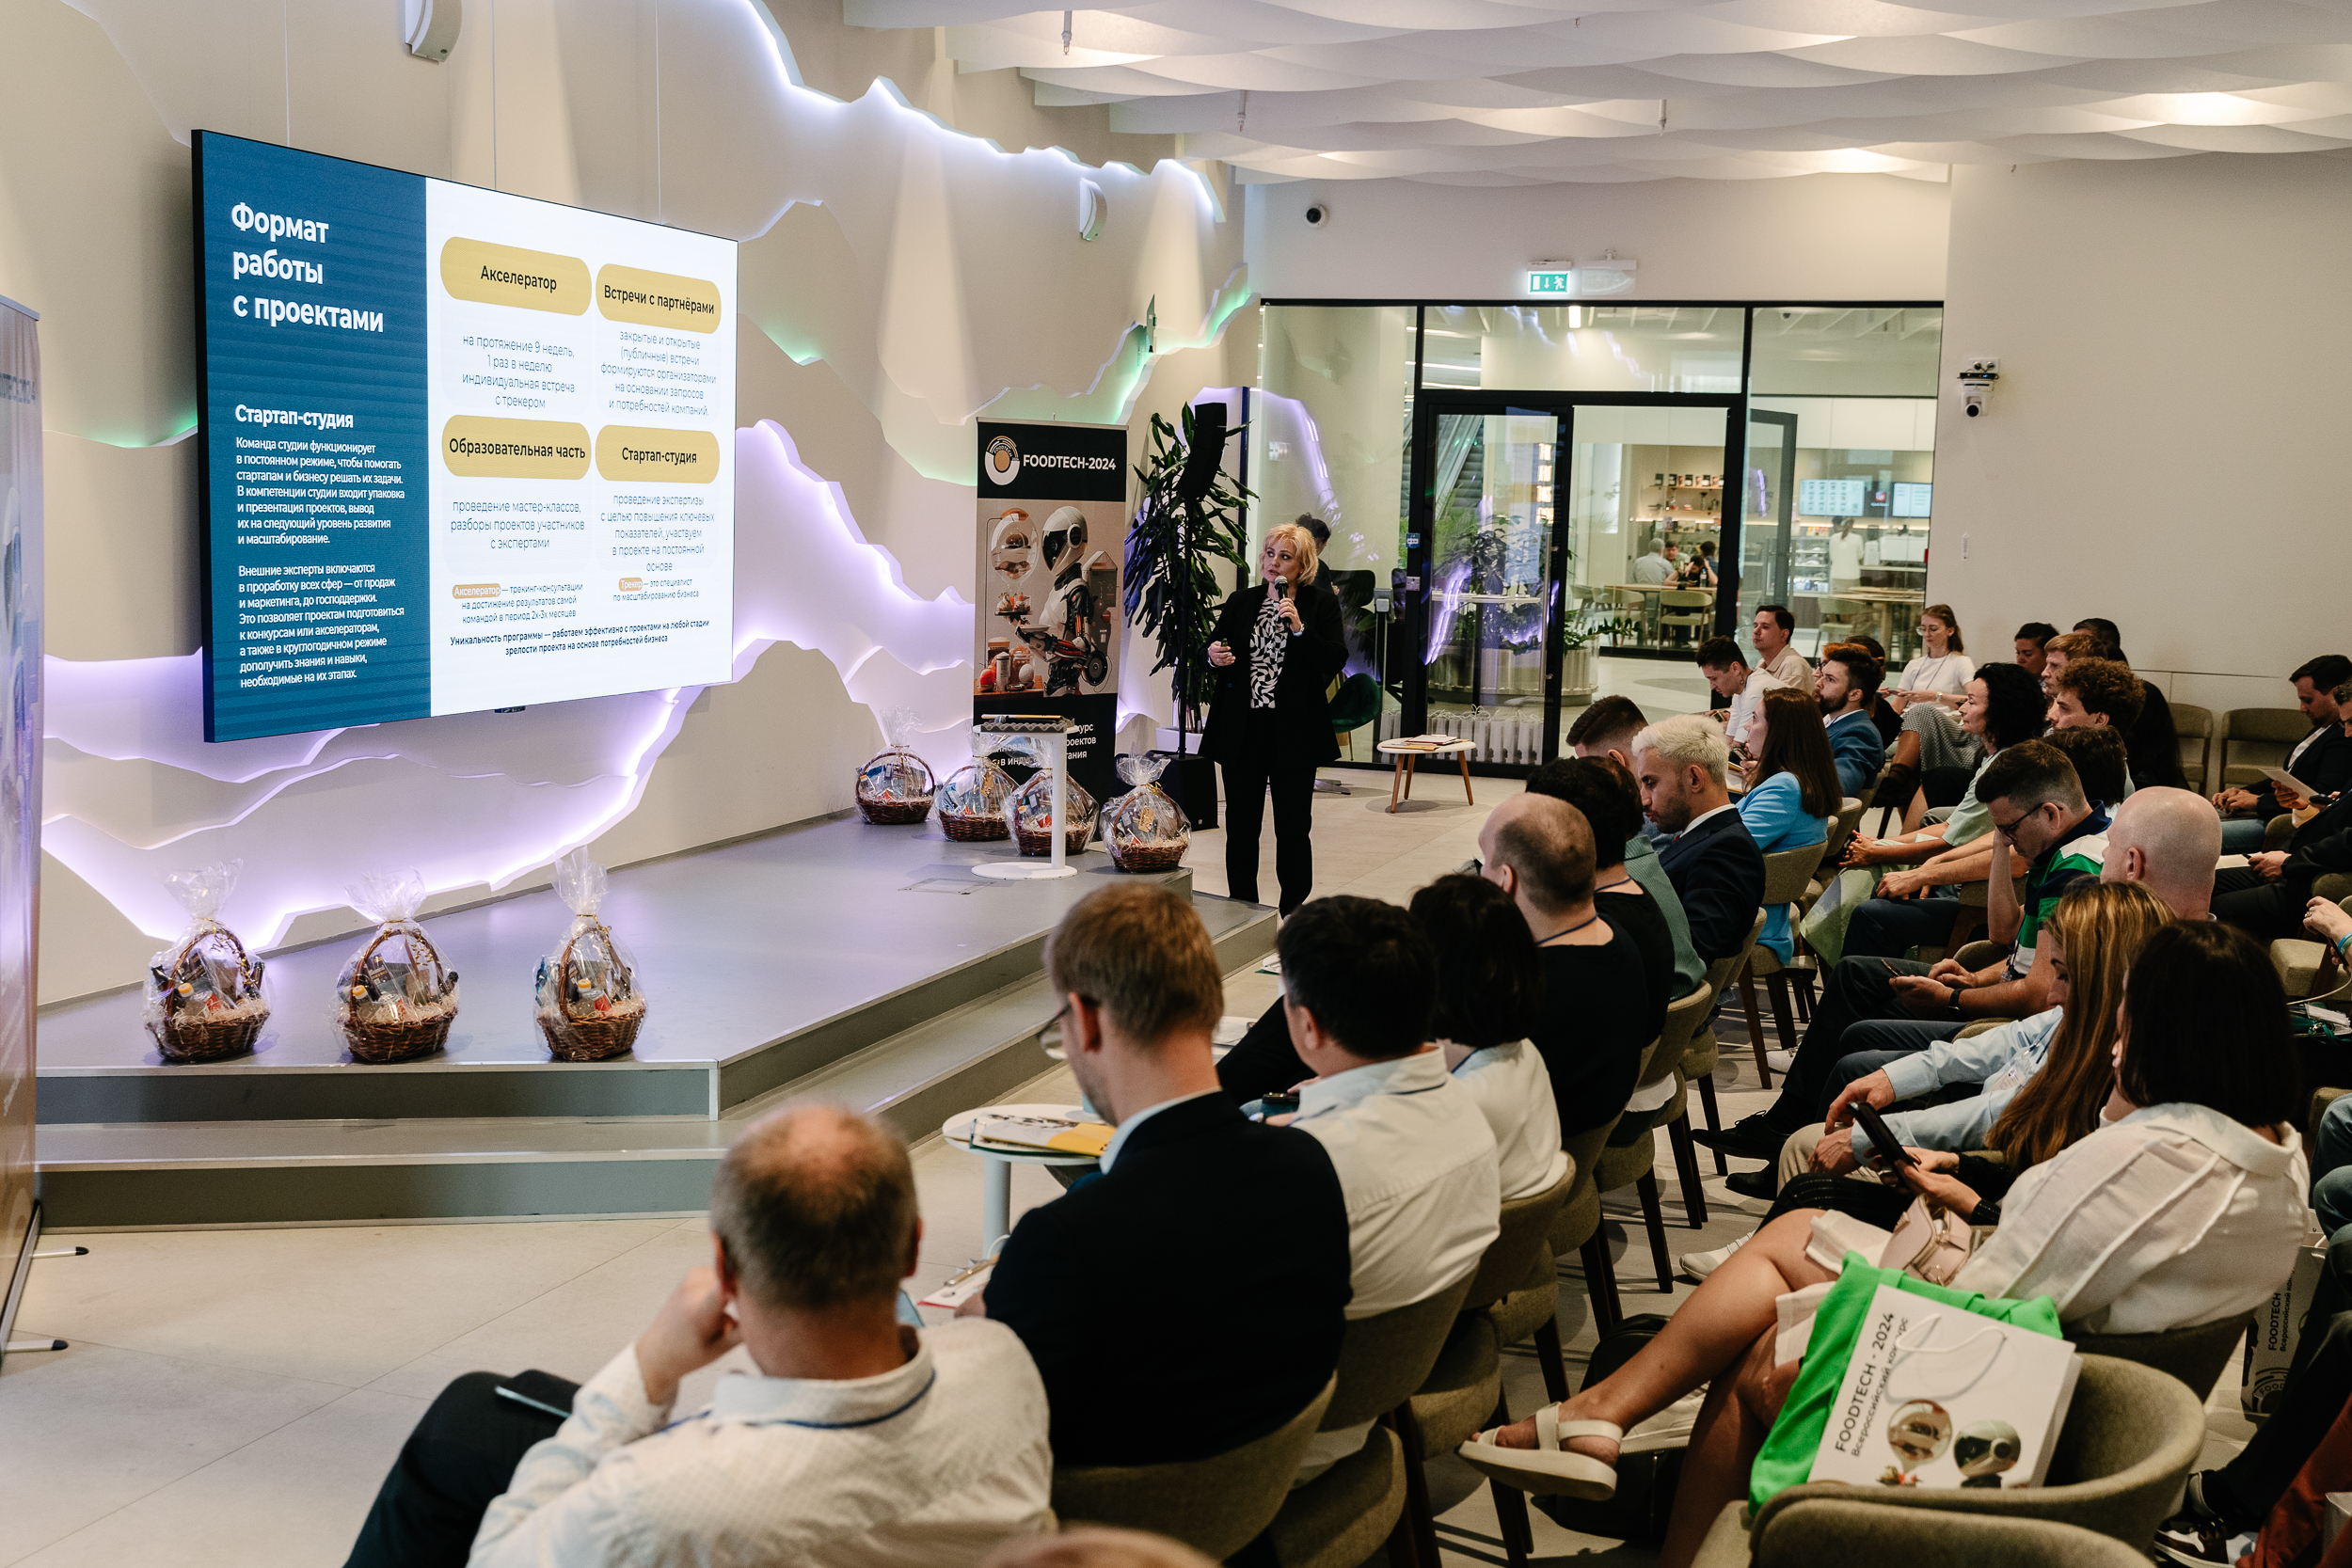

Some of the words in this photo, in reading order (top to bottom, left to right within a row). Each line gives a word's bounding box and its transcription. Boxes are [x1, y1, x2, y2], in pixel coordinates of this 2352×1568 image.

[230, 201, 329, 243] Формат
[232, 248, 323, 284] работы
[480, 264, 557, 293] Акселератор
[604, 284, 646, 304] Встречи
[648, 294, 655, 305] с
[657, 295, 714, 314] партнёрами
[231, 294, 248, 317] с
[254, 296, 384, 332] проектами
[462, 336, 474, 346] на
[476, 337, 533, 352] протяжение
[534, 341, 541, 353] 9
[619, 330, 658, 344] закрытые
[665, 337, 700, 349] открытые
[620, 346, 668, 364] (публичные)
[669, 354, 699, 366] встречи
[492, 357, 509, 369] раз
[511, 359, 516, 369] в
[517, 360, 552, 372] неделю
[600, 363, 655, 379] формируются
[656, 370, 716, 384] организаторами
[462, 373, 539, 390] индивидуальная
[541, 381, 575, 393] встреча
[614, 383, 625, 392] на
[626, 384, 669, 395] основании
[669, 388, 704, 400] запросов
[495, 395, 501, 405] с
[501, 396, 546, 410] трекером
[608, 400, 614, 408] и
[616, 399, 670, 413] потребностей
[234, 404, 354, 430] Стартап-студия
[235, 436, 277, 451] Команда
[277, 440, 309, 452] студии
[309, 439, 376, 455] функционирует
[449, 436, 553, 457] Образовательная
[555, 446, 586, 458] часть
[243, 455, 299, 466] постоянном
[336, 456, 363, 467] чтобы
[363, 459, 402, 469] помогать
[621, 447, 697, 466] Стартап-студия
[1024, 453, 1117, 470] FOODTECH-2024
[235, 470, 284, 483] стартапам
[292, 469, 329, 484] бизнесу
[329, 473, 362, 484] решать
[361, 474, 373, 483] их
[245, 487, 307, 499] компетенции
[307, 488, 338, 499] студии
[338, 489, 368, 499] входит
[367, 489, 405, 500] упаковка
[612, 495, 660, 506] проведение
[661, 496, 704, 505] экспертизы
[245, 503, 305, 515] презентация
[347, 504, 375, 515] вывод
[452, 501, 510, 514] проведение
[512, 502, 581, 514] мастер-классов,
[236, 519, 250, 529] их
[249, 519, 262, 529] на
[262, 516, 316, 531] следующий
[315, 519, 353, 531] уровень
[353, 519, 391, 531] развития
[450, 517, 491, 533] разборы
[493, 520, 535, 532] проектов
[536, 520, 584, 533] участников
[607, 513, 632, 522] целью
[633, 513, 678, 522] повышения
[679, 513, 714, 521] ключевых
[245, 531, 330, 546] масштабирование.
[665, 529, 702, 541] участвуем
[490, 539, 496, 548] с
[497, 539, 549, 550] экспертами
[618, 546, 650, 555] проекте
[651, 546, 660, 555] на
[661, 543, 704, 554] постоянной
[237, 565, 282, 577] Внешние
[282, 565, 325, 577] эксперты
[325, 563, 375, 574] включаются
[645, 562, 673, 572] основе
[246, 578, 300, 594] проработку
[299, 580, 321, 590] всех
[320, 578, 343, 592] сфер
[353, 578, 364, 588] от
[363, 578, 396, 590] продаж
[453, 584, 501, 598] Акселератор
[509, 583, 583, 594] трекинг-консультации
[620, 579, 642, 591] Трекер
[660, 578, 692, 587] специалист
[302, 596, 315, 607] до
[314, 594, 378, 606] господдержки.
[470, 599, 515, 610] достижение
[516, 597, 555, 609] результатов
[556, 594, 577, 605] самой
[621, 589, 675, 601] масштабированию
[675, 589, 699, 598] бизнеса
[238, 613, 257, 625] Это
[256, 612, 304, 624] позволяет
[304, 610, 345, 623] проектам
[345, 607, 405, 619] подготовиться
[462, 612, 498, 624] командой
[504, 612, 531, 621] период
[548, 610, 576, 618] месяцев
[246, 628, 295, 641] конкурсам
[295, 626, 314, 637] или
[449, 635, 502, 646] Уникальность
[502, 632, 543, 643] программы
[551, 627, 583, 640] работаем
[583, 626, 624, 637] эффективно
[628, 624, 661, 633] проектами
[670, 619, 690, 628] любой
[246, 645, 275, 656] также
[282, 640, 354, 655] круглогодичном
[354, 637, 388, 650] режиме
[504, 645, 537, 657] зрелости
[538, 643, 566, 654] проекта
[576, 641, 599, 649] основе
[600, 635, 644, 647] потребностей
[644, 634, 668, 643] бизнеса
[238, 659, 294, 673] дополучить
[294, 657, 326, 668] знания
[239, 673, 303, 688] необходимые
[303, 673, 315, 682] на
[315, 672, 327, 681] их
[326, 669, 358, 680] этапах.
[2268, 1292, 2281, 1351] FOODTECH
[2280, 1292, 2291, 1352] Всероссийский
[1835, 1361, 1876, 1452] FOODTECH
[1871, 1311, 1895, 1351] 2024
[1850, 1367, 1891, 1457] Всероссийский
